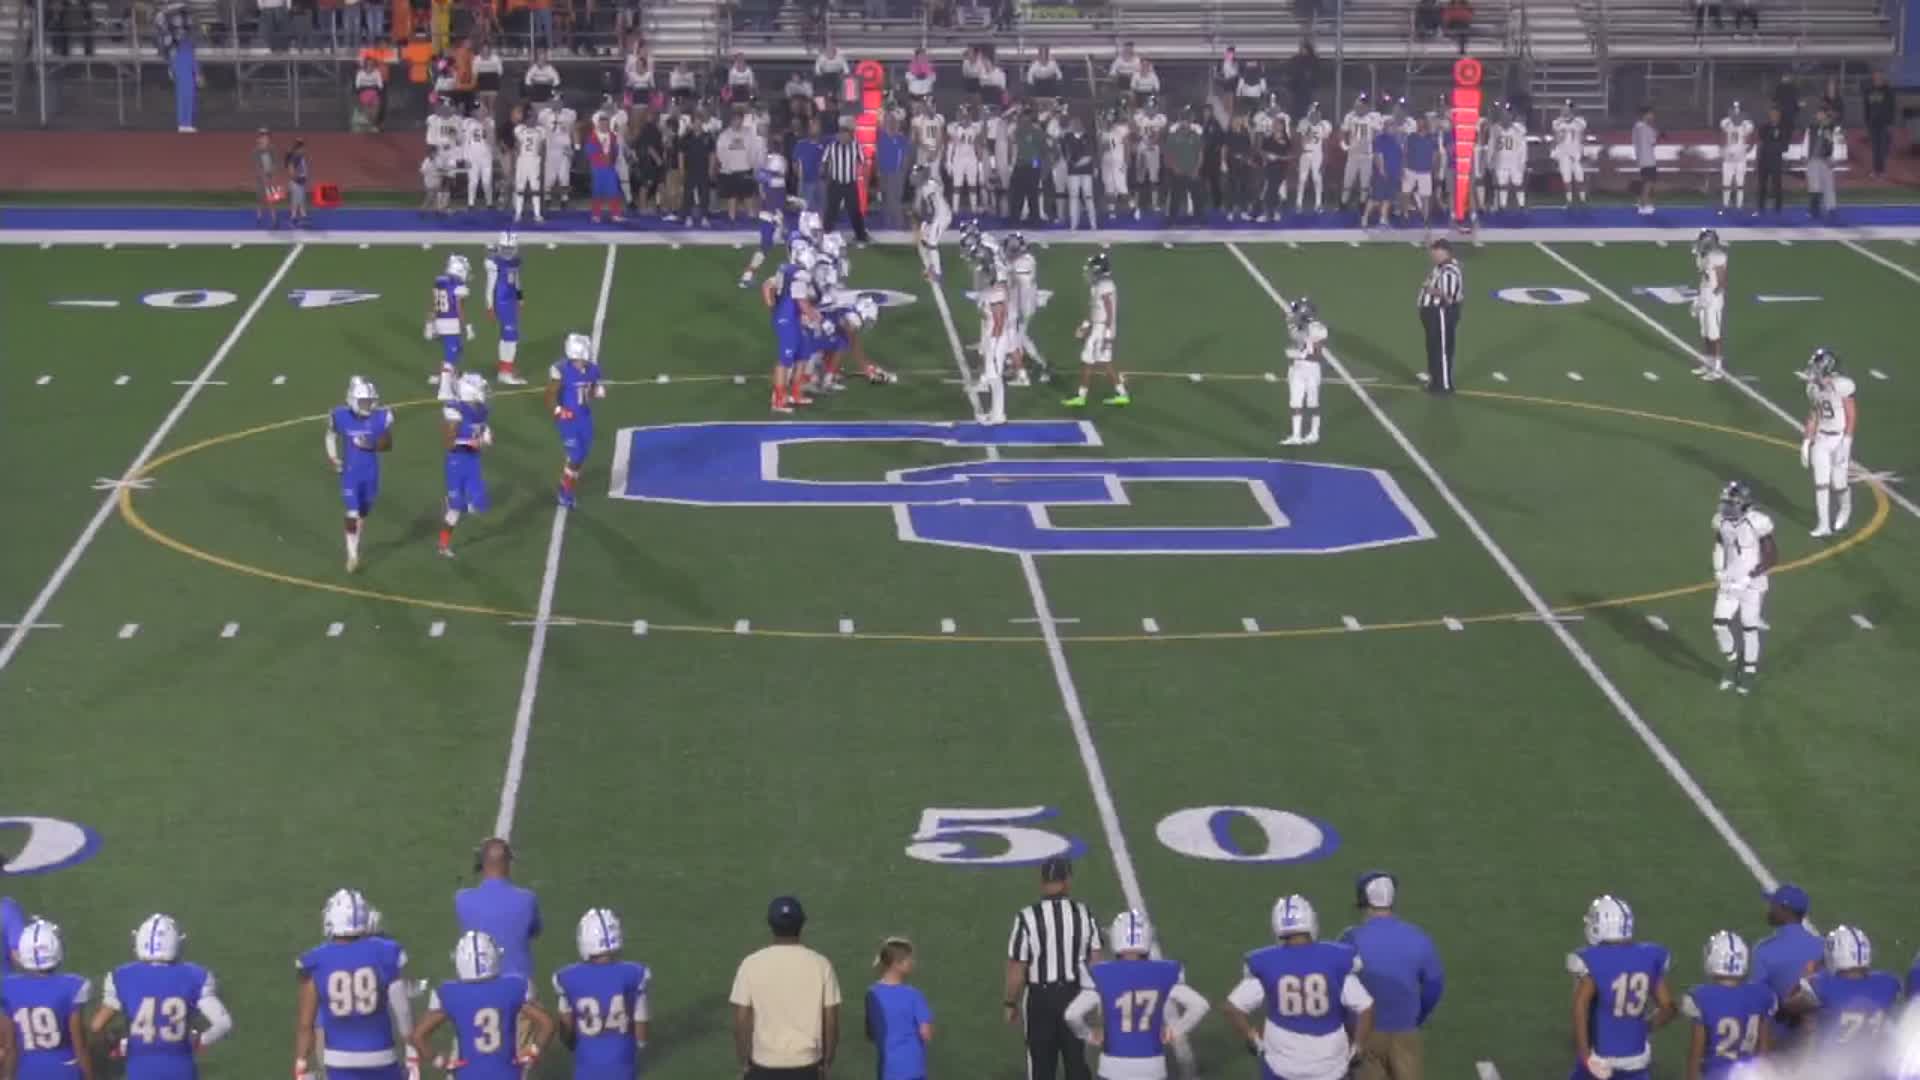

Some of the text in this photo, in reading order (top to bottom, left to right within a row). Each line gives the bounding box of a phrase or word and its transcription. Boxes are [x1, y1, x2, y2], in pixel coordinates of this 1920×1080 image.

[328, 967, 379, 1017] 99
[1115, 989, 1159, 1033] 17
[1278, 973, 1330, 1017] 68
[1611, 972, 1649, 1018] 13
[14, 1006, 61, 1050] 19
[130, 997, 187, 1044] 43
[473, 1008, 501, 1053] 3
[576, 995, 629, 1036] 34
[1715, 1014, 1761, 1060] 24
